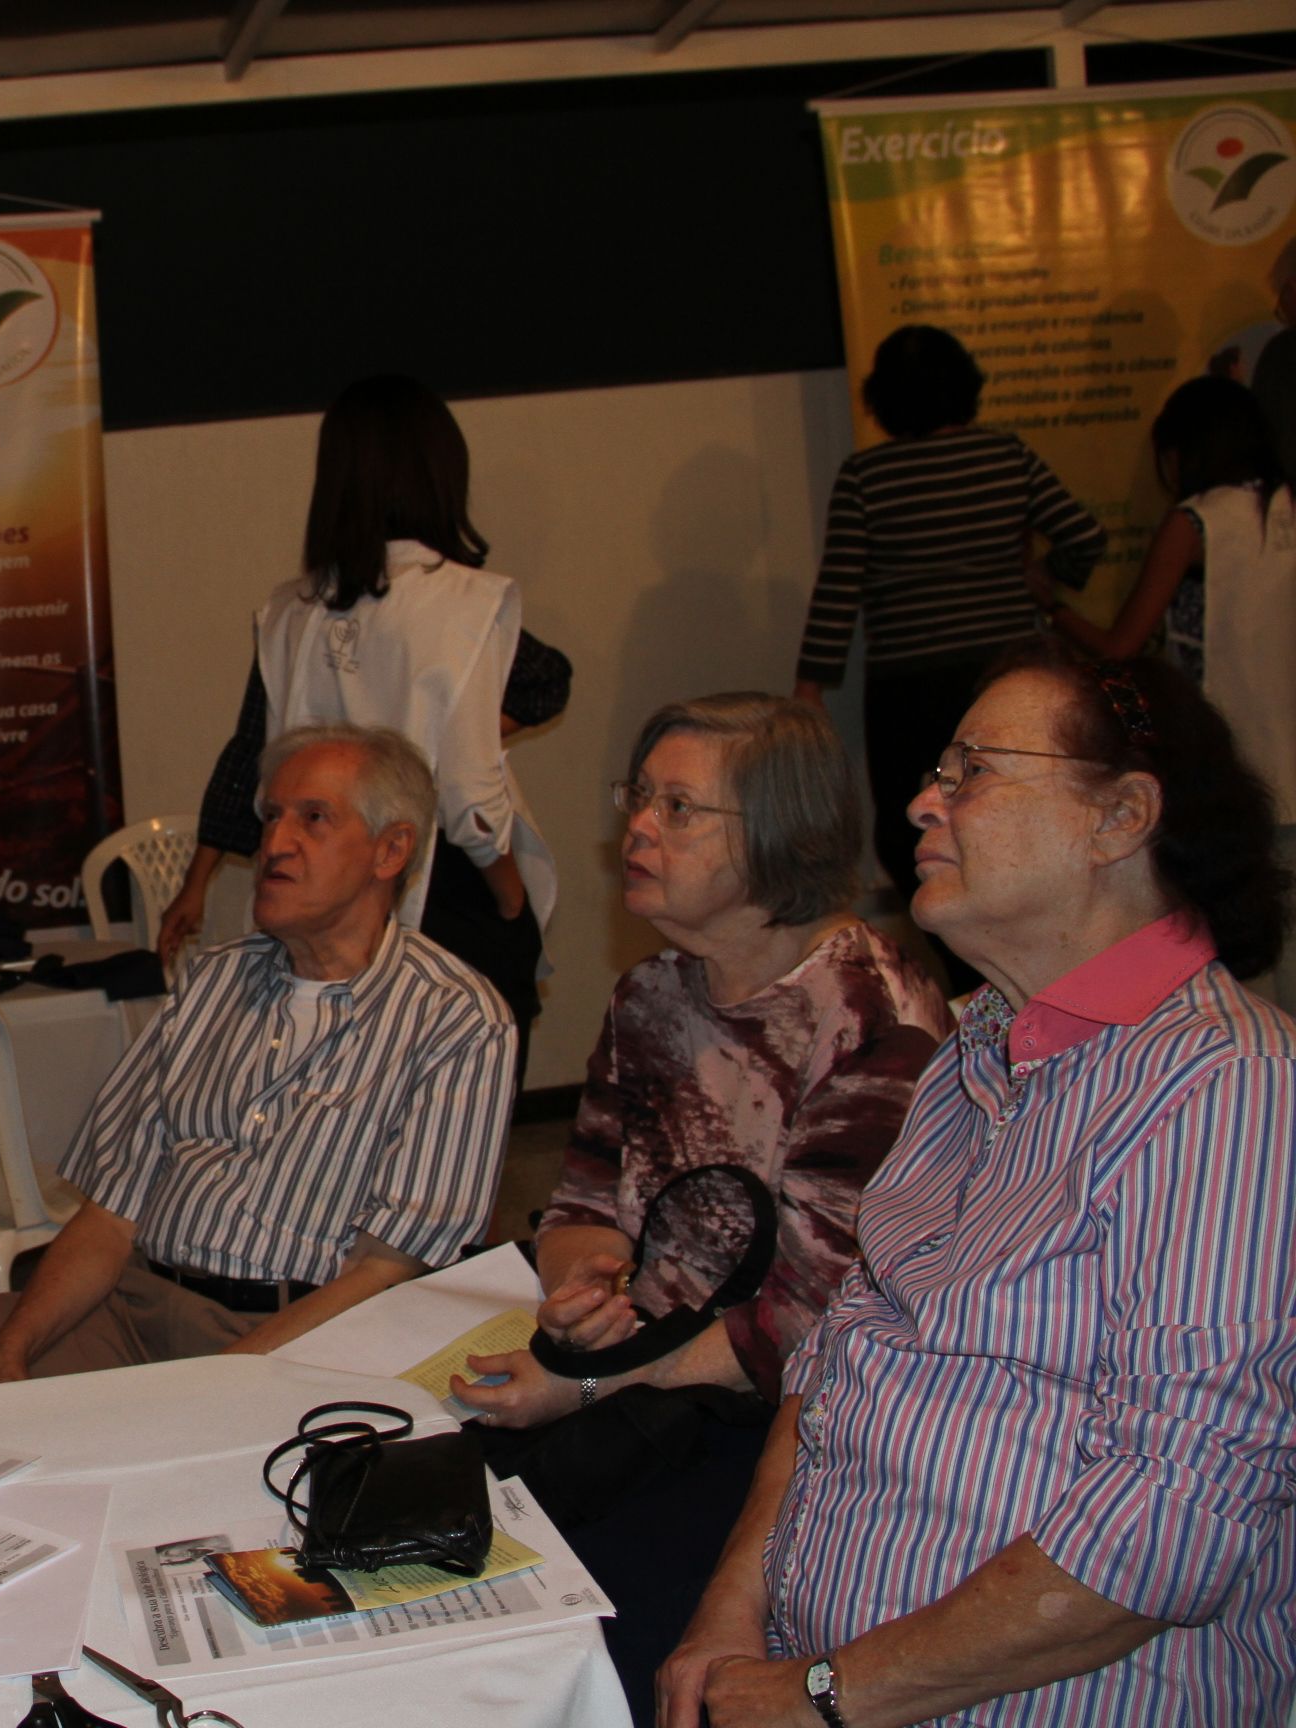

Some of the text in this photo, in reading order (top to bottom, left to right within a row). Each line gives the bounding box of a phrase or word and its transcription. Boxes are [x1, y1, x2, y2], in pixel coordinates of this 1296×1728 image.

[841, 120, 1011, 164] Exercício
[41, 653, 63, 667] as
[18, 702, 59, 717] casa
